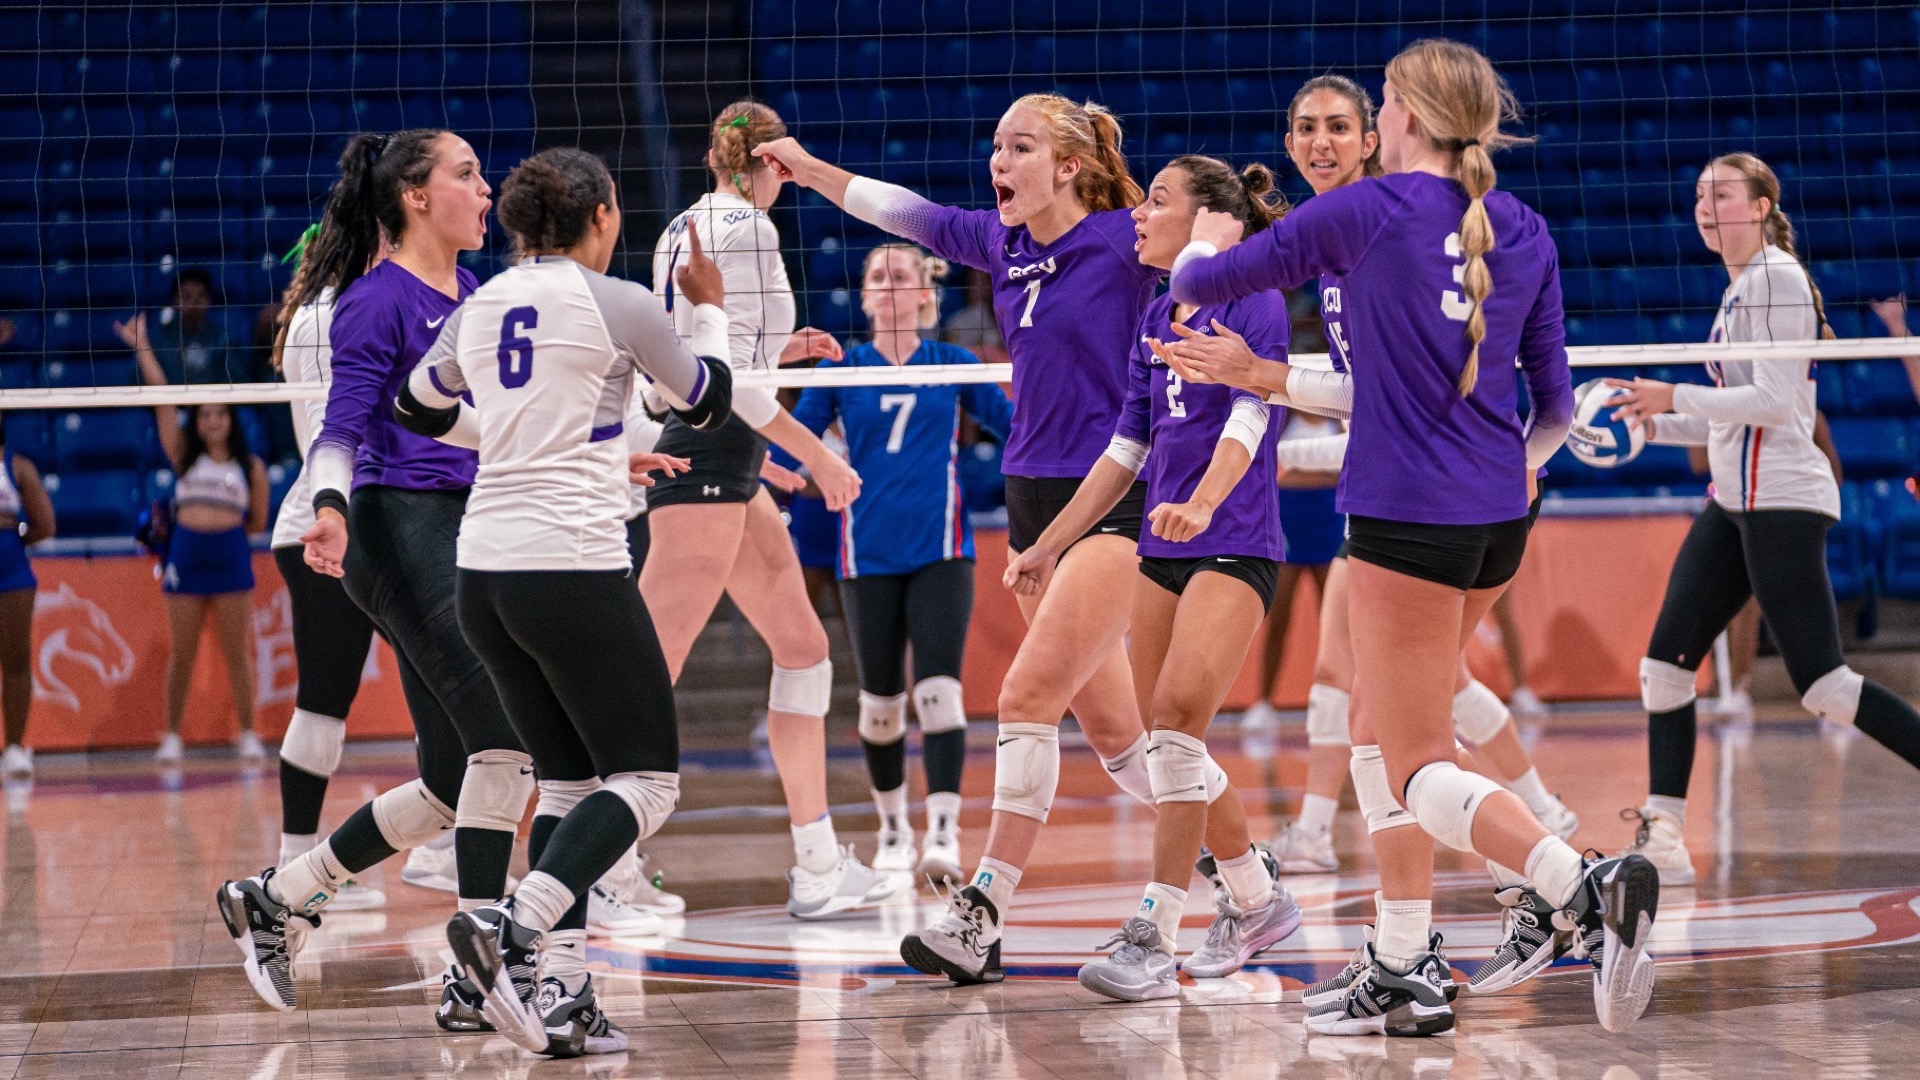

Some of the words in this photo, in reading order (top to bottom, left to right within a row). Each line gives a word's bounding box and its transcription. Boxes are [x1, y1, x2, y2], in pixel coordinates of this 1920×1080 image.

[1019, 279, 1041, 328] 7
[1440, 231, 1477, 322] 3
[496, 305, 539, 390] 6
[880, 392, 917, 454] 7
[1166, 368, 1187, 418] 2
